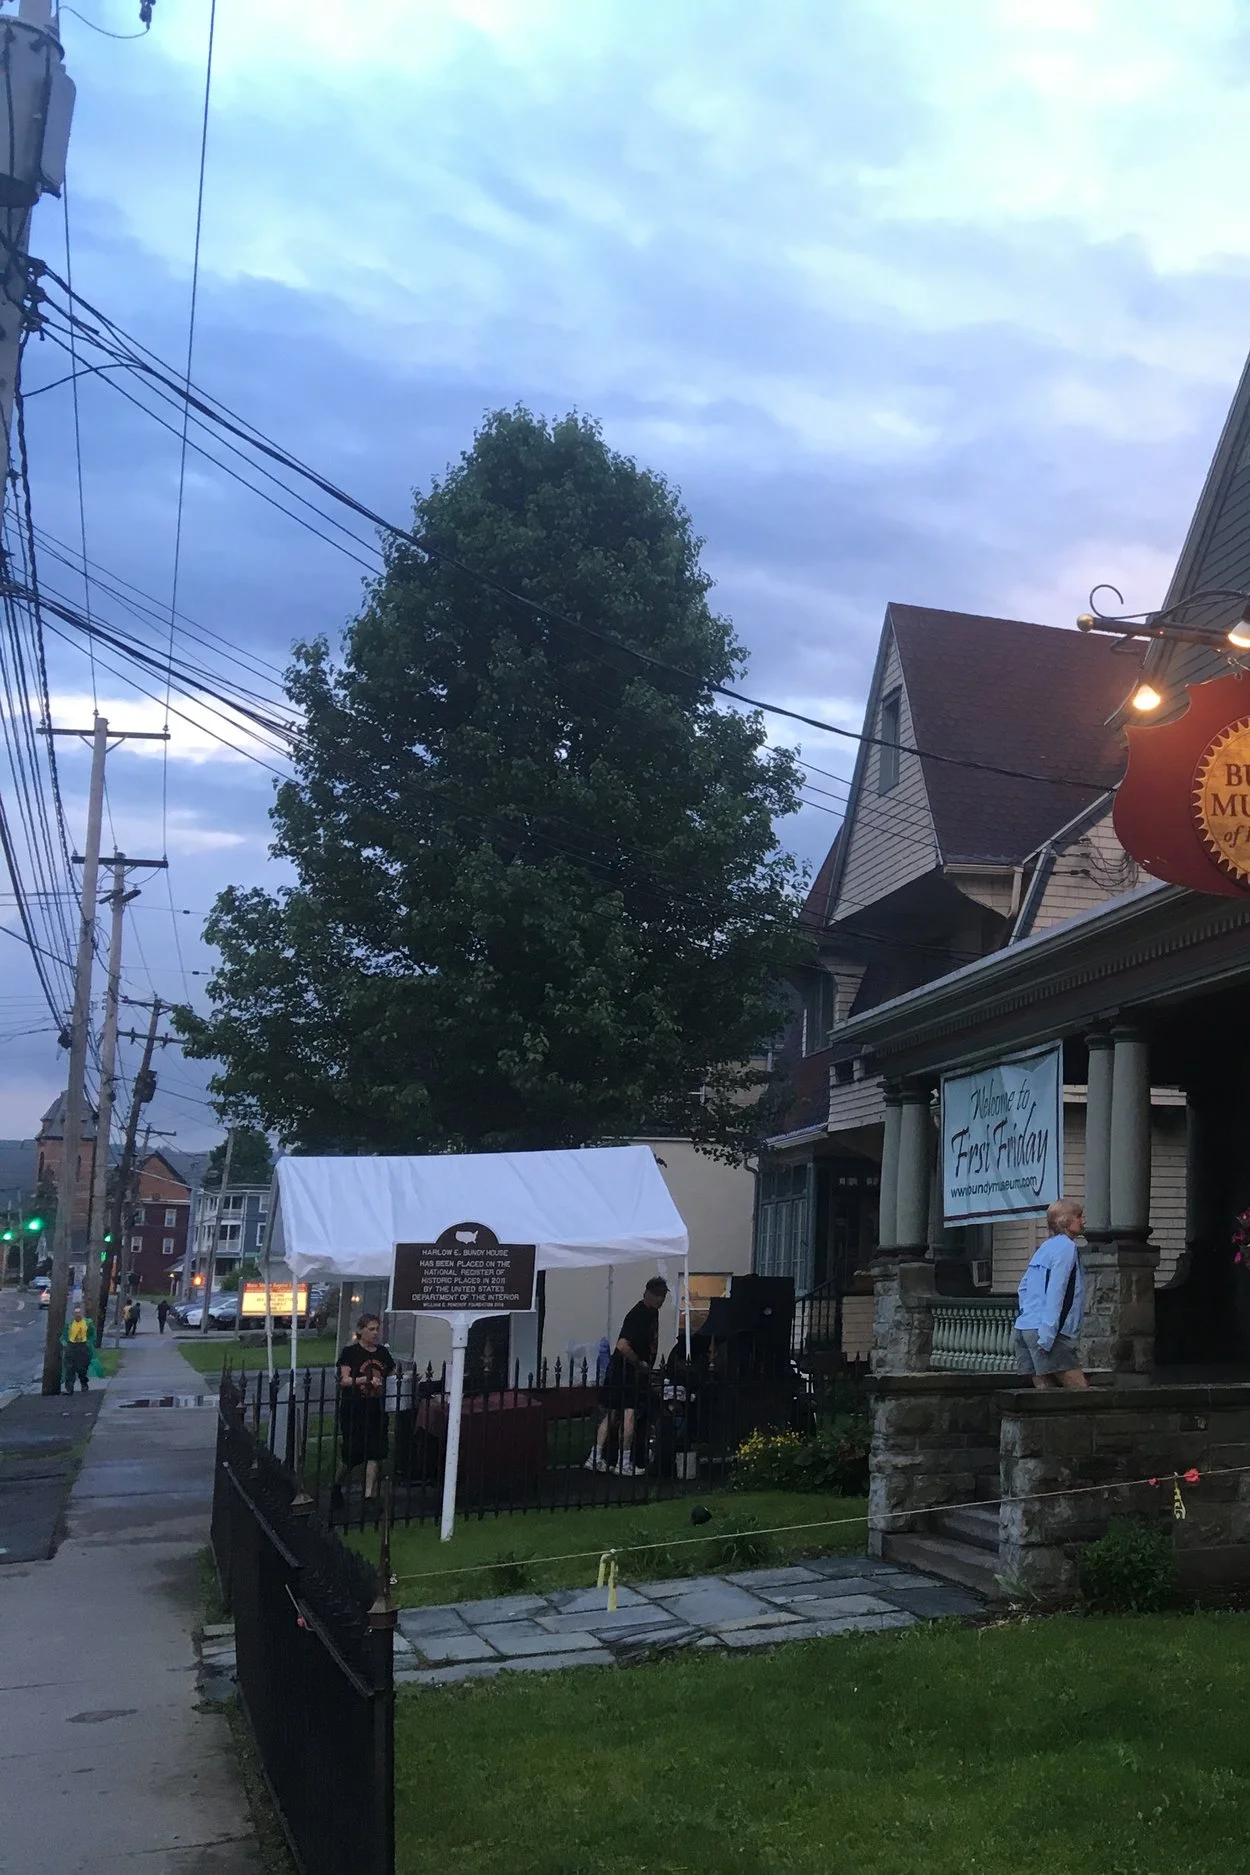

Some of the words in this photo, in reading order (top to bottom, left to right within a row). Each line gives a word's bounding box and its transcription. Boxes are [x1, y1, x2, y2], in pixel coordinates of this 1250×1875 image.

[1223, 825, 1245, 848] of
[971, 1078, 1016, 1120] Welcome
[1016, 1078, 1031, 1111] to
[993, 1101, 1049, 1197] Friday
[950, 1175, 1038, 1198] wwwbundymseum.com
